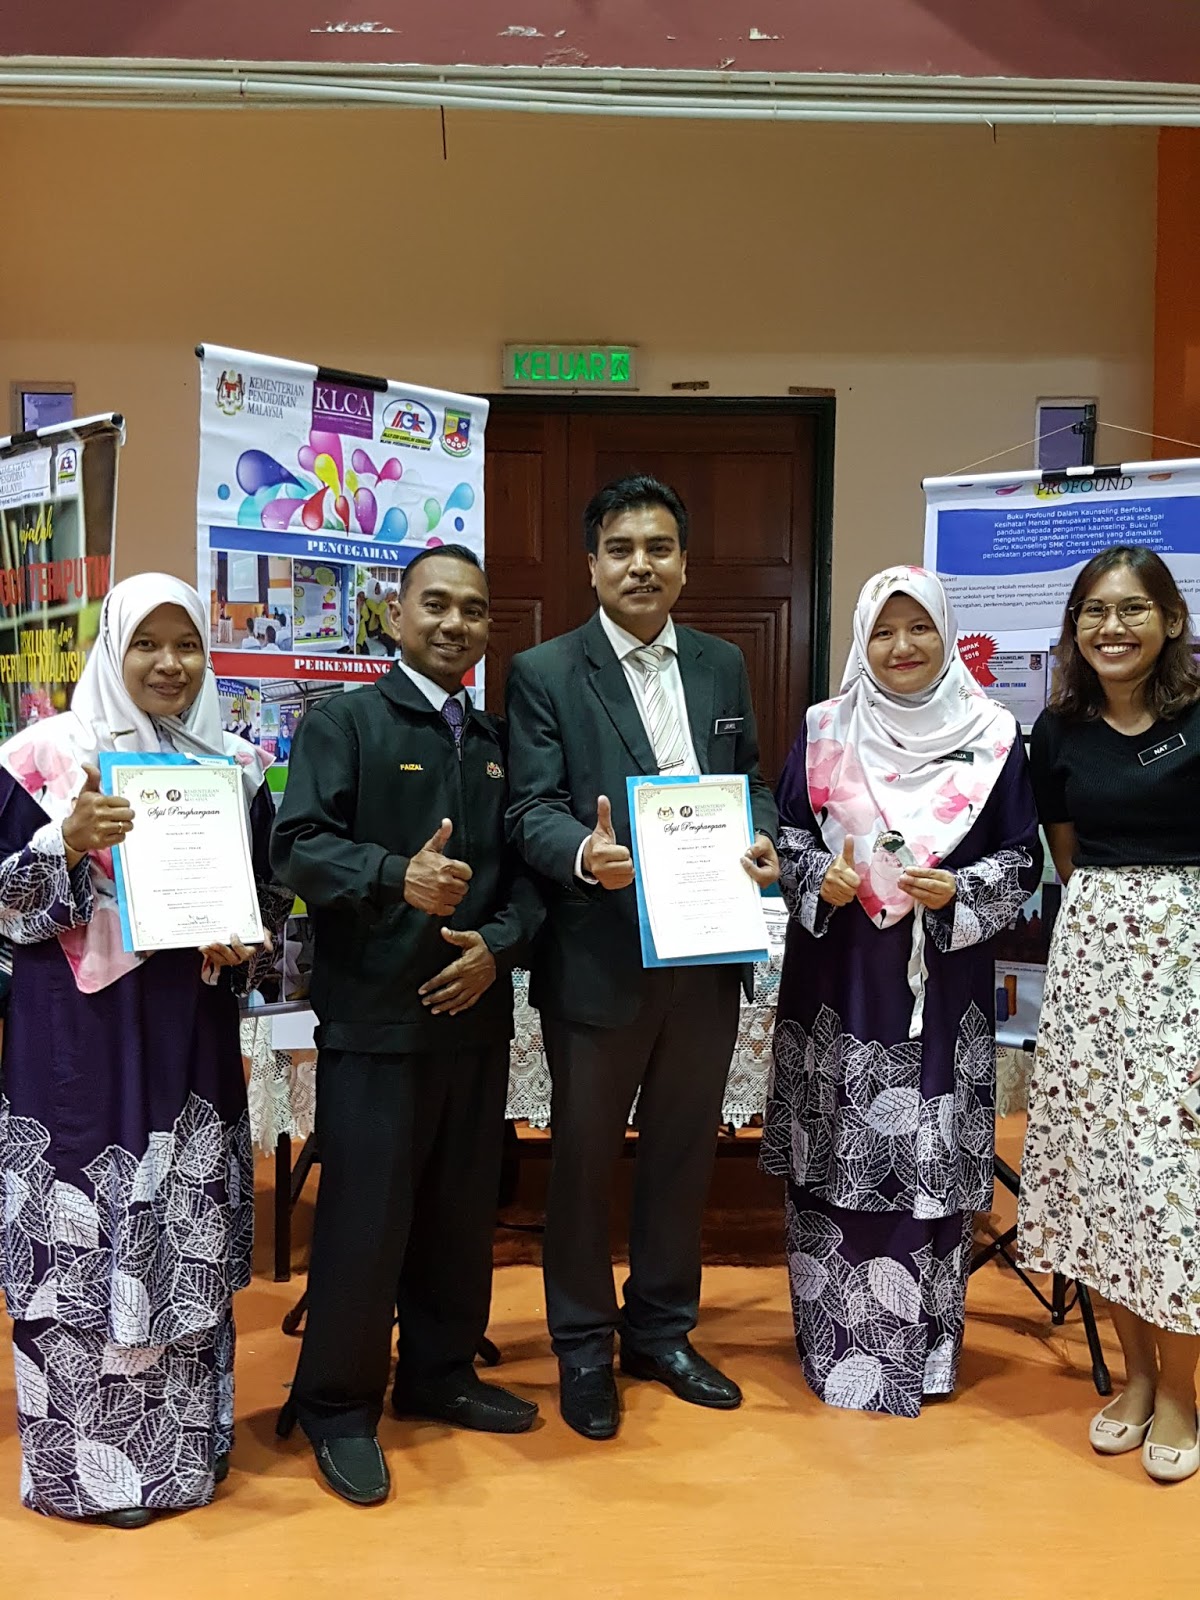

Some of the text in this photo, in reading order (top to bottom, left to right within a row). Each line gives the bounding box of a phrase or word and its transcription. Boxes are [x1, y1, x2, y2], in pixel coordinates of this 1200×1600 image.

[513, 352, 606, 380] KELUAR
[249, 377, 305, 396] KEMENTERIAN
[248, 390, 297, 408] PENDIDIKAN
[315, 387, 372, 417] KLCA
[247, 402, 284, 419] MALAYSIA
[1036, 477, 1133, 496] PROFOUND
[1025, 511, 1055, 519] Profound
[1081, 507, 1118, 516] Kaunseling
[1120, 506, 1151, 514] Berfokus
[994, 520, 1026, 528] Kesihatan
[1028, 519, 1050, 527] Mental
[1052, 517, 1091, 526] merupakan
[1137, 513, 1164, 521] sebagai
[993, 535, 1038, 544] mengandungi
[1039, 533, 1068, 542] panduan
[1106, 531, 1123, 539] yang
[1125, 529, 1162, 537] diamalkan
[997, 529, 1025, 537] panduan
[1027, 527, 1051, 535] kepada
[1053, 525, 1086, 534] pengamal
[1088, 522, 1127, 531] kaunseling.
[307, 540, 399, 561] PENCEGAHAN
[1011, 542, 1047, 550] Kaunseling
[1065, 540, 1089, 548] Cheras
[1113, 537, 1164, 545] melaksanakan
[1022, 549, 1065, 557] pencegahan,
[960, 642, 980, 653] IMPAK
[294, 658, 391, 674] PERKEMBANG
[1153, 744, 1168, 755] NAT
[167, 805, 220, 819] Penghargaan
[681, 821, 727, 834] Penghargaan
